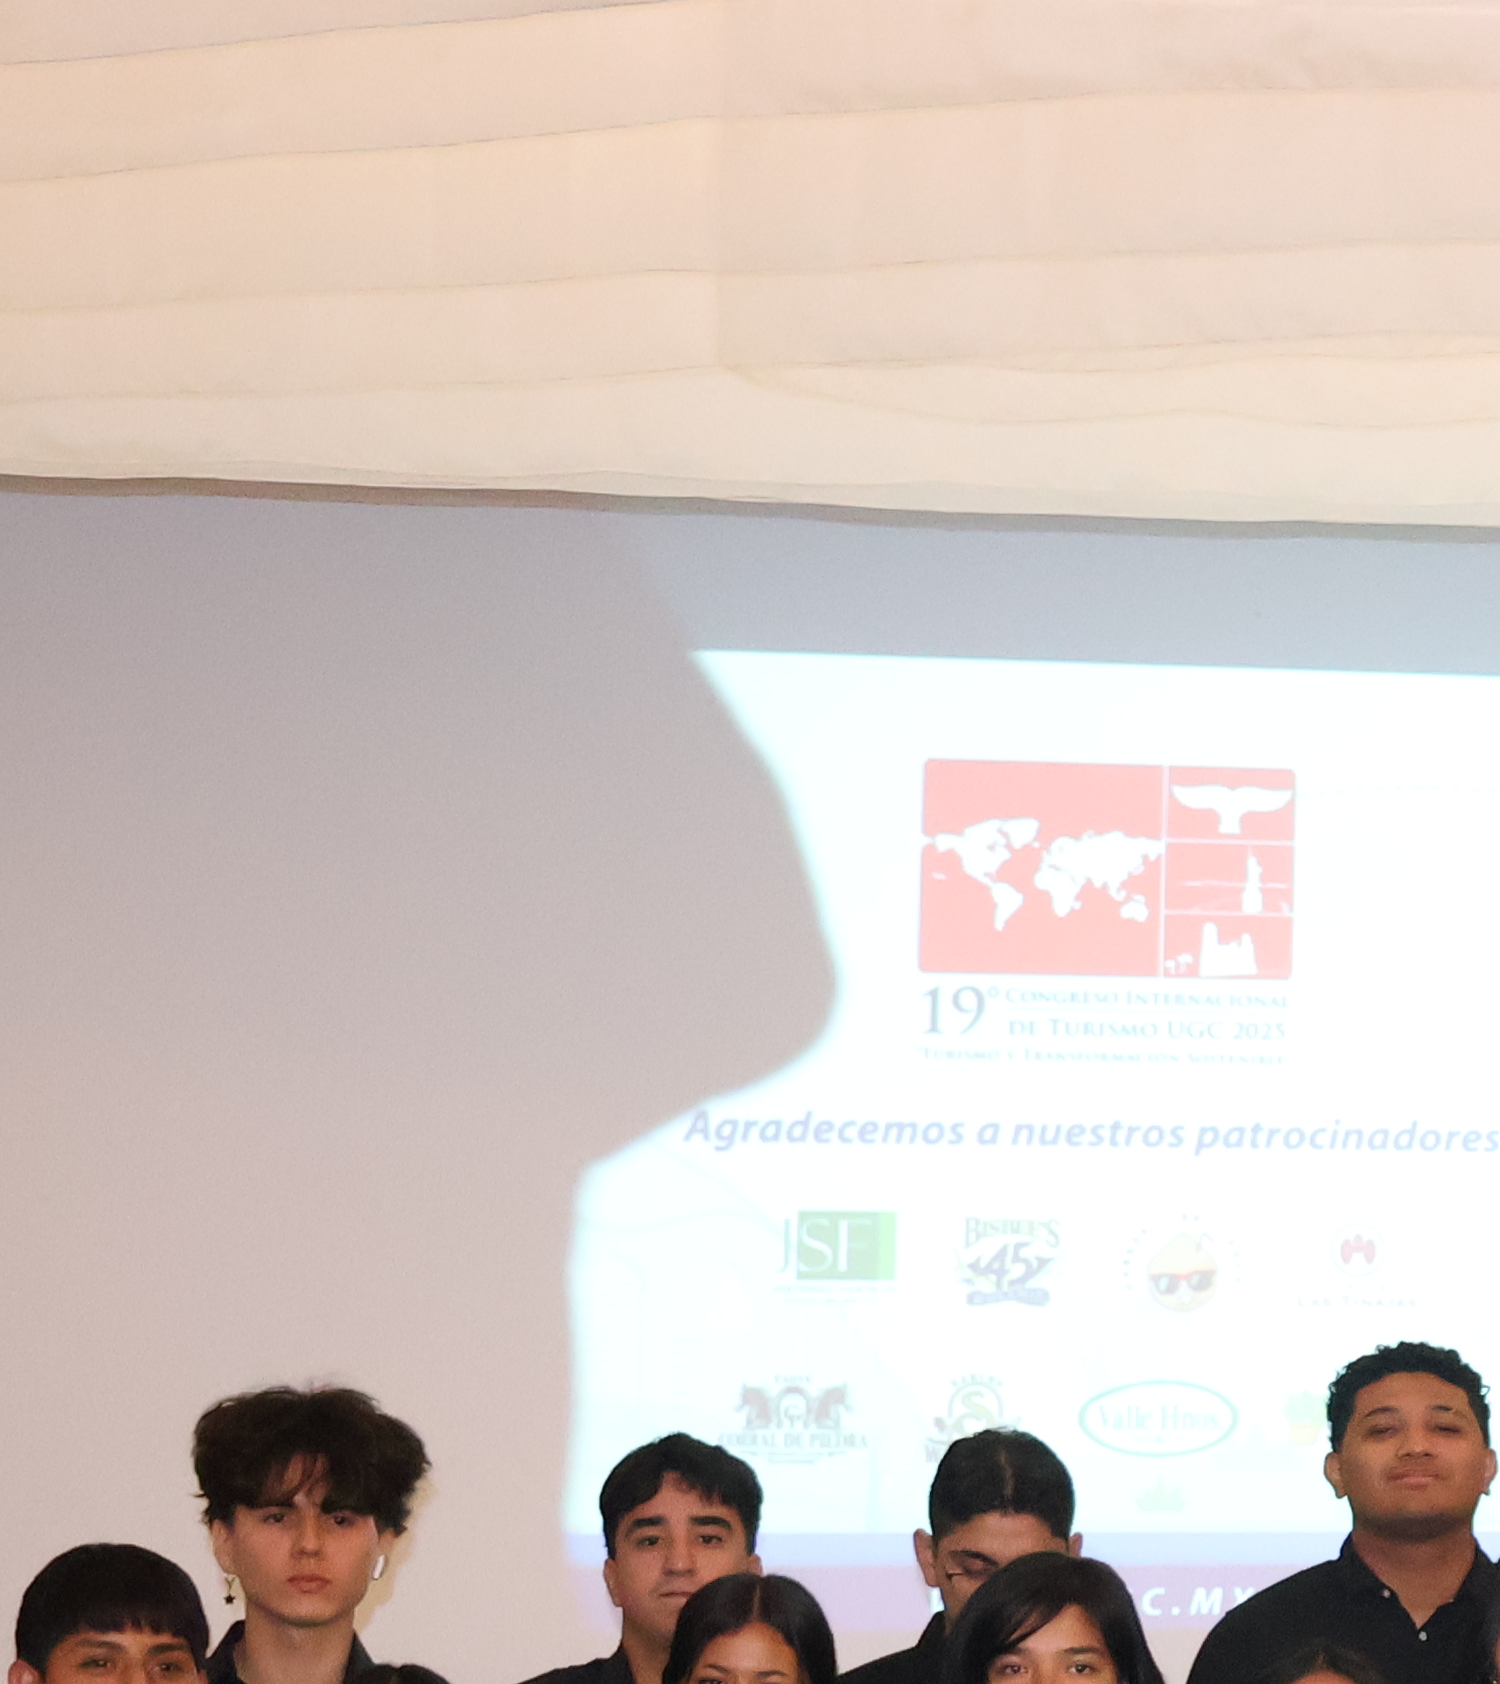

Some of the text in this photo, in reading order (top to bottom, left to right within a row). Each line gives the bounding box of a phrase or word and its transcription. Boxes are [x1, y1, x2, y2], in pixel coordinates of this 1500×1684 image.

[1004, 987, 1119, 1005] CONGRESO
[1126, 990, 1288, 1009] INTERNACIONAL
[1049, 1017, 1159, 1038] TURISMO
[1167, 1020, 1222, 1040] UGC
[1232, 1022, 1286, 1041] 2025
[683, 1110, 1500, 1157] Agradecemos a nuestros patrocinadores
